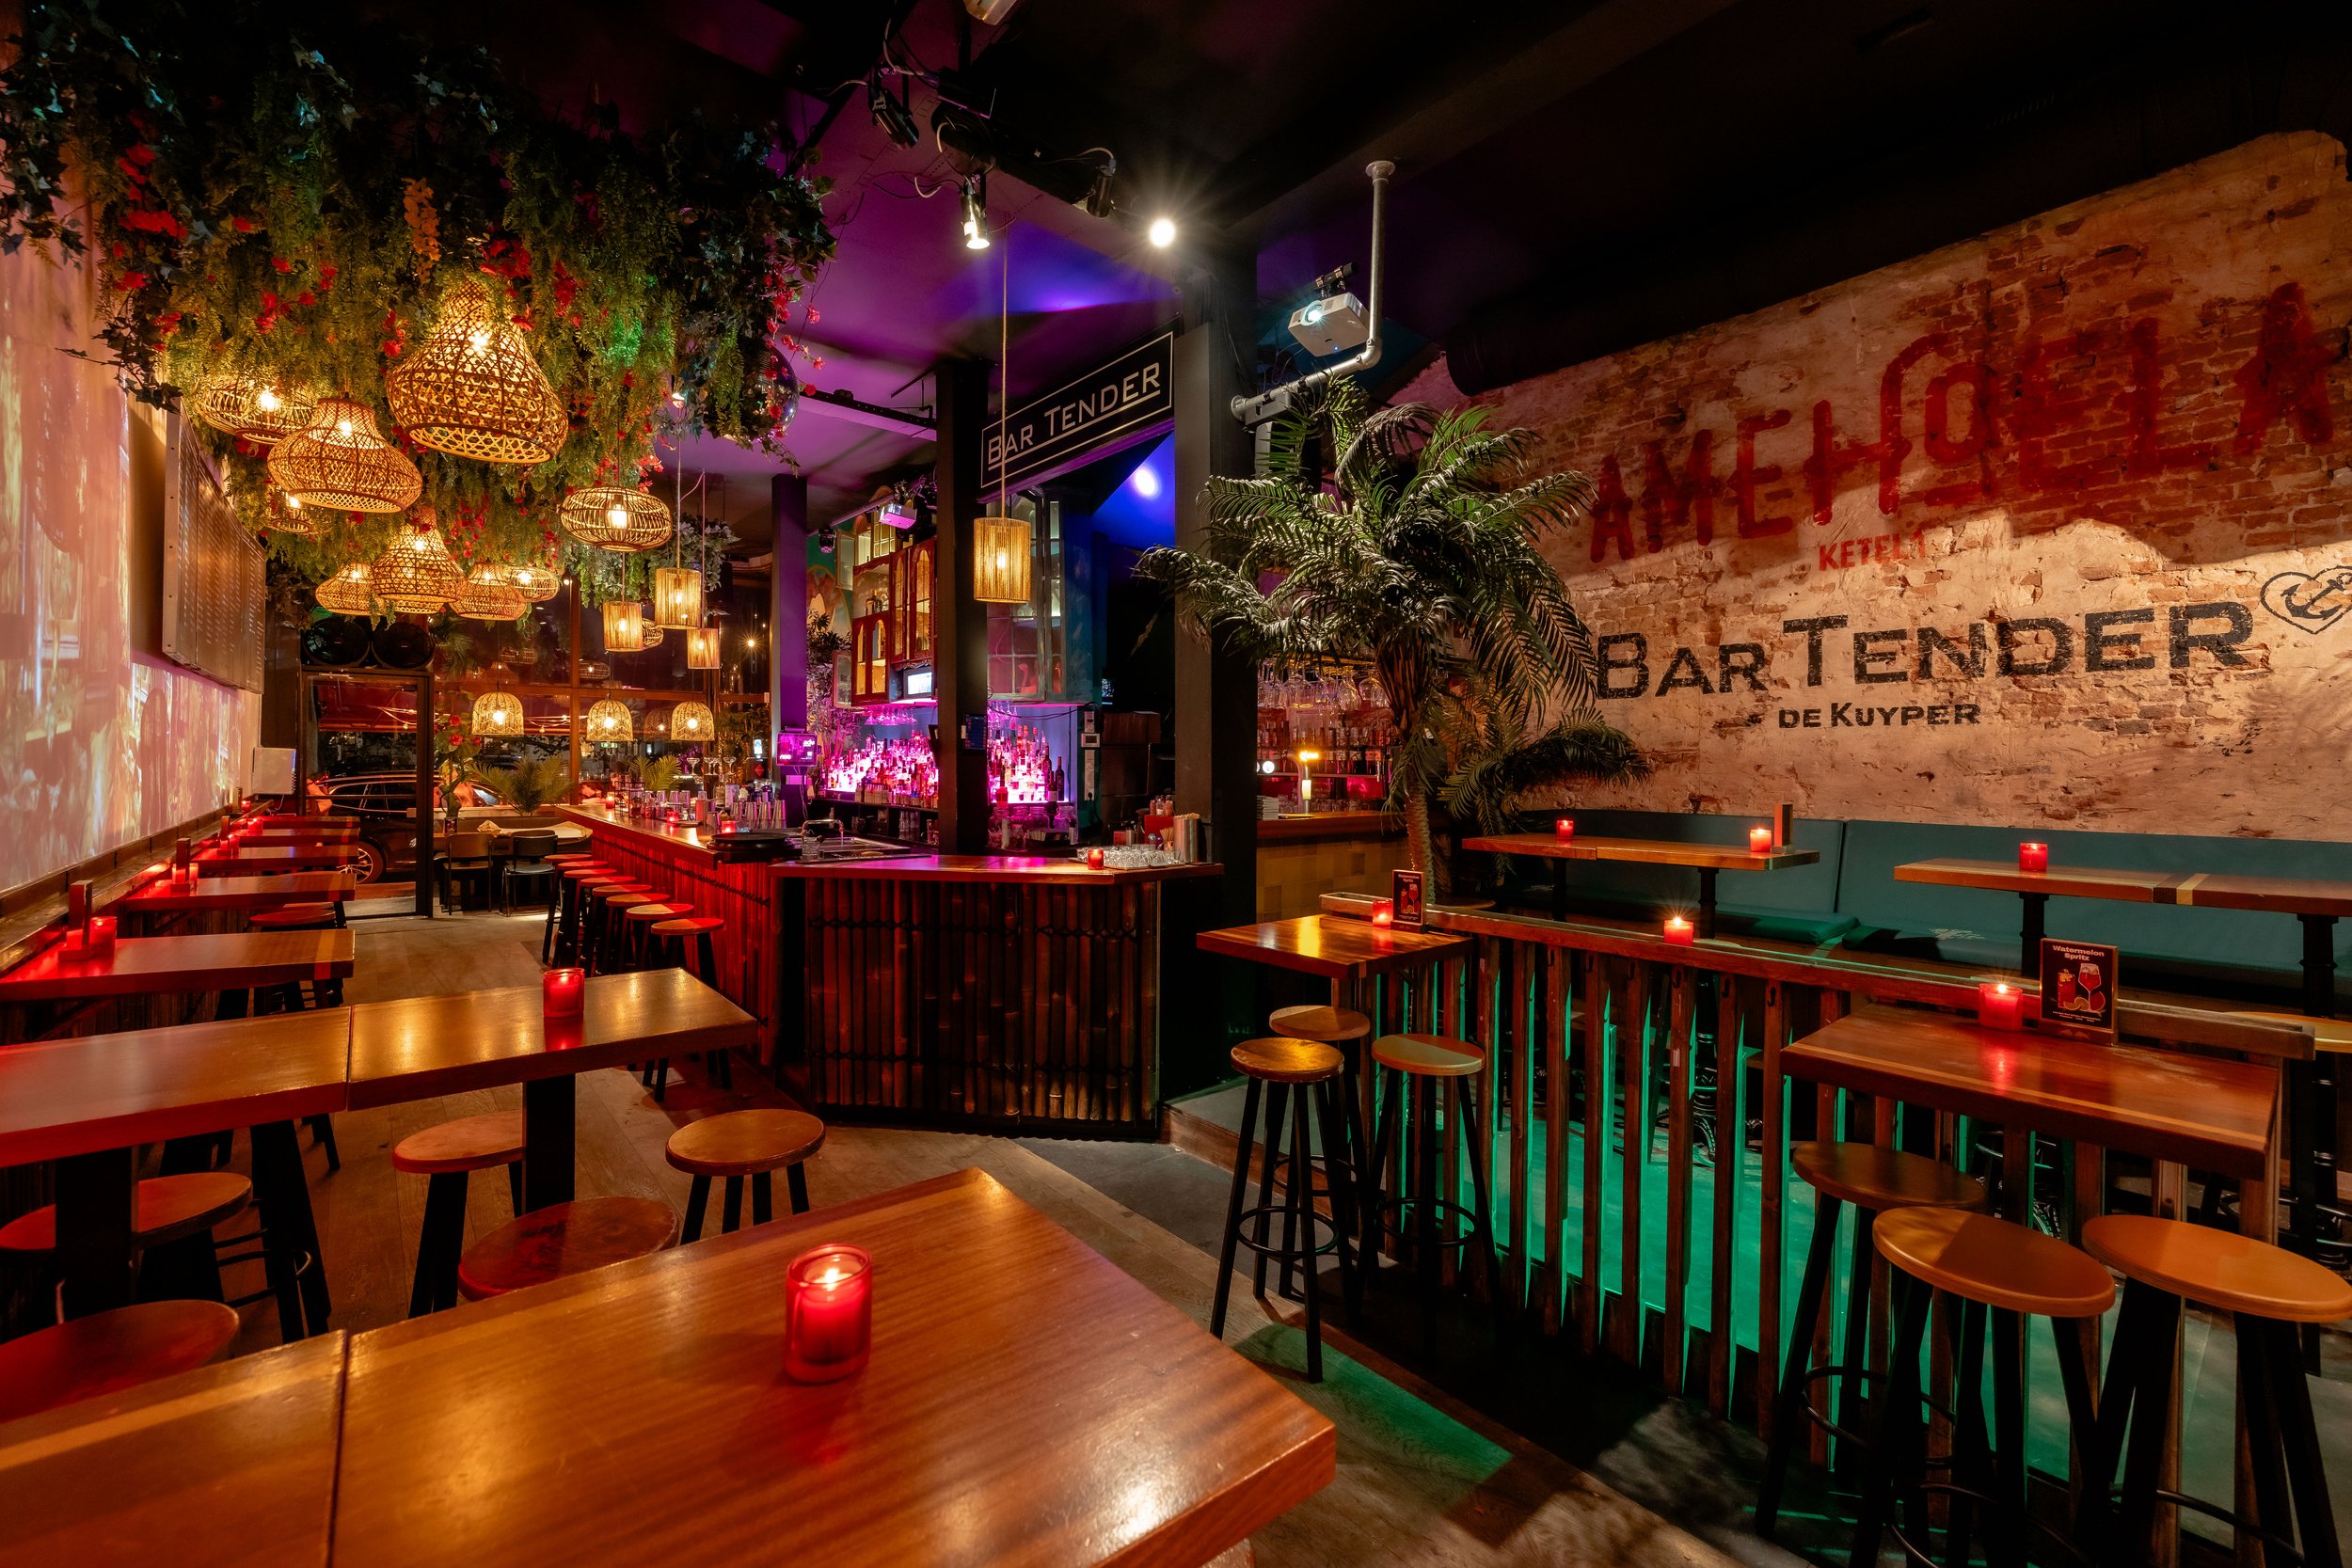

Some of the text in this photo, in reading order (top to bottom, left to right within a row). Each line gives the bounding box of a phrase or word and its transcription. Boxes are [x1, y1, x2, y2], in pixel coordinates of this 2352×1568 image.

[988, 362, 1161, 465] BAR TENDER
[1597, 601, 2254, 700] BAR TENDER
[1778, 702, 1980, 729] DE KUYPER
[2052, 944, 2105, 958] Watermelon
[2064, 952, 2090, 961] Spritz
